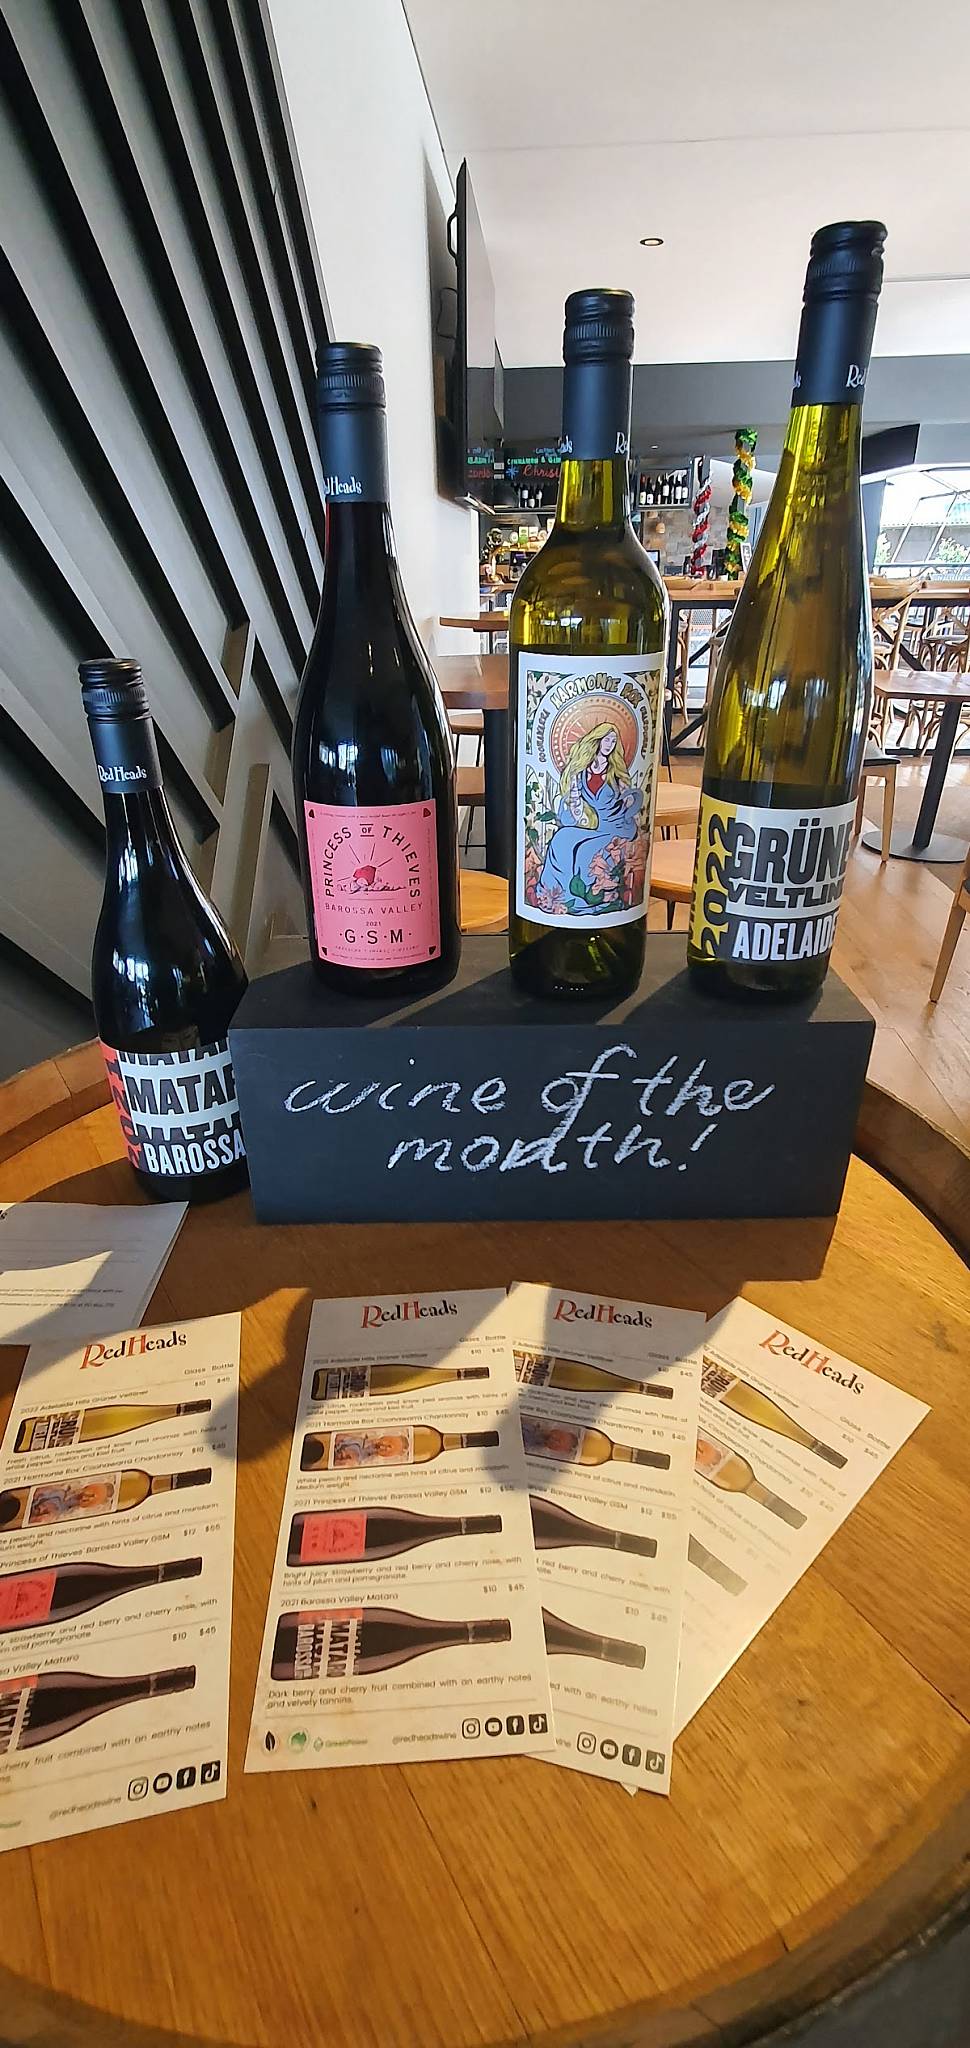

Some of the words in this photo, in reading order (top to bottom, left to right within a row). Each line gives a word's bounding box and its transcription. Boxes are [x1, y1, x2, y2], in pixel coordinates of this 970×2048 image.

[550, 673, 622, 709] HARMONIE
[97, 764, 148, 783] RedHeads
[323, 826, 352, 898] PRINCESS
[382, 825, 421, 898] THIEVES
[325, 902, 374, 915] BAROSSA
[380, 902, 424, 915] VALLEY
[284, 1057, 507, 1114] wine
[541, 1043, 637, 1140] of
[633, 1055, 775, 1118] the
[143, 1128, 247, 1175] BAROSSA
[360, 1299, 458, 1329] RedHeads
[553, 1299, 653, 1329] RedHeads
[80, 1330, 188, 1370] RedHeads
[759, 1329, 865, 1396] RedHeads
[423, 1489, 448, 1499] Valley
[584, 1493, 609, 1508] Valley
[86, 1541, 121, 1556] Barossa
[122, 1536, 149, 1549] Valley
[151, 1532, 171, 1544] GSM
[300, 1596, 337, 1607] Barossa
[338, 1593, 365, 1605] Valley
[366, 1591, 399, 1602] Mataro
[483, 1584, 497, 1594] $10
[507, 1582, 525, 1592] $45
[124, 1612, 142, 1622] and
[145, 1606, 172, 1619] cherry
[201, 1597, 218, 1608] with
[172, 1632, 187, 1643] $10
[199, 1626, 217, 1638] $45
[13, 1661, 42, 1674] Valley
[44, 1653, 80, 1667] Mataro
[268, 1688, 289, 1699] Dark
[292, 1686, 315, 1699] berry
[319, 1686, 337, 1696] and
[340, 1684, 368, 1697] cherry
[371, 1682, 388, 1692] fruit
[392, 1679, 436, 1691] combined
[439, 1678, 458, 1688] with
[461, 1677, 473, 1686] an
[476, 1674, 504, 1686] earthy
[507, 1672, 532, 1683] notes
[564, 1685, 582, 1697] with
[600, 1694, 631, 1711] earthy
[266, 1698, 285, 1710] and
[286, 1696, 318, 1710] velvety
[111, 1737, 131, 1749] with
[134, 1734, 148, 1744] an
[151, 1726, 182, 1741] earthy
[185, 1720, 211, 1733] notes
